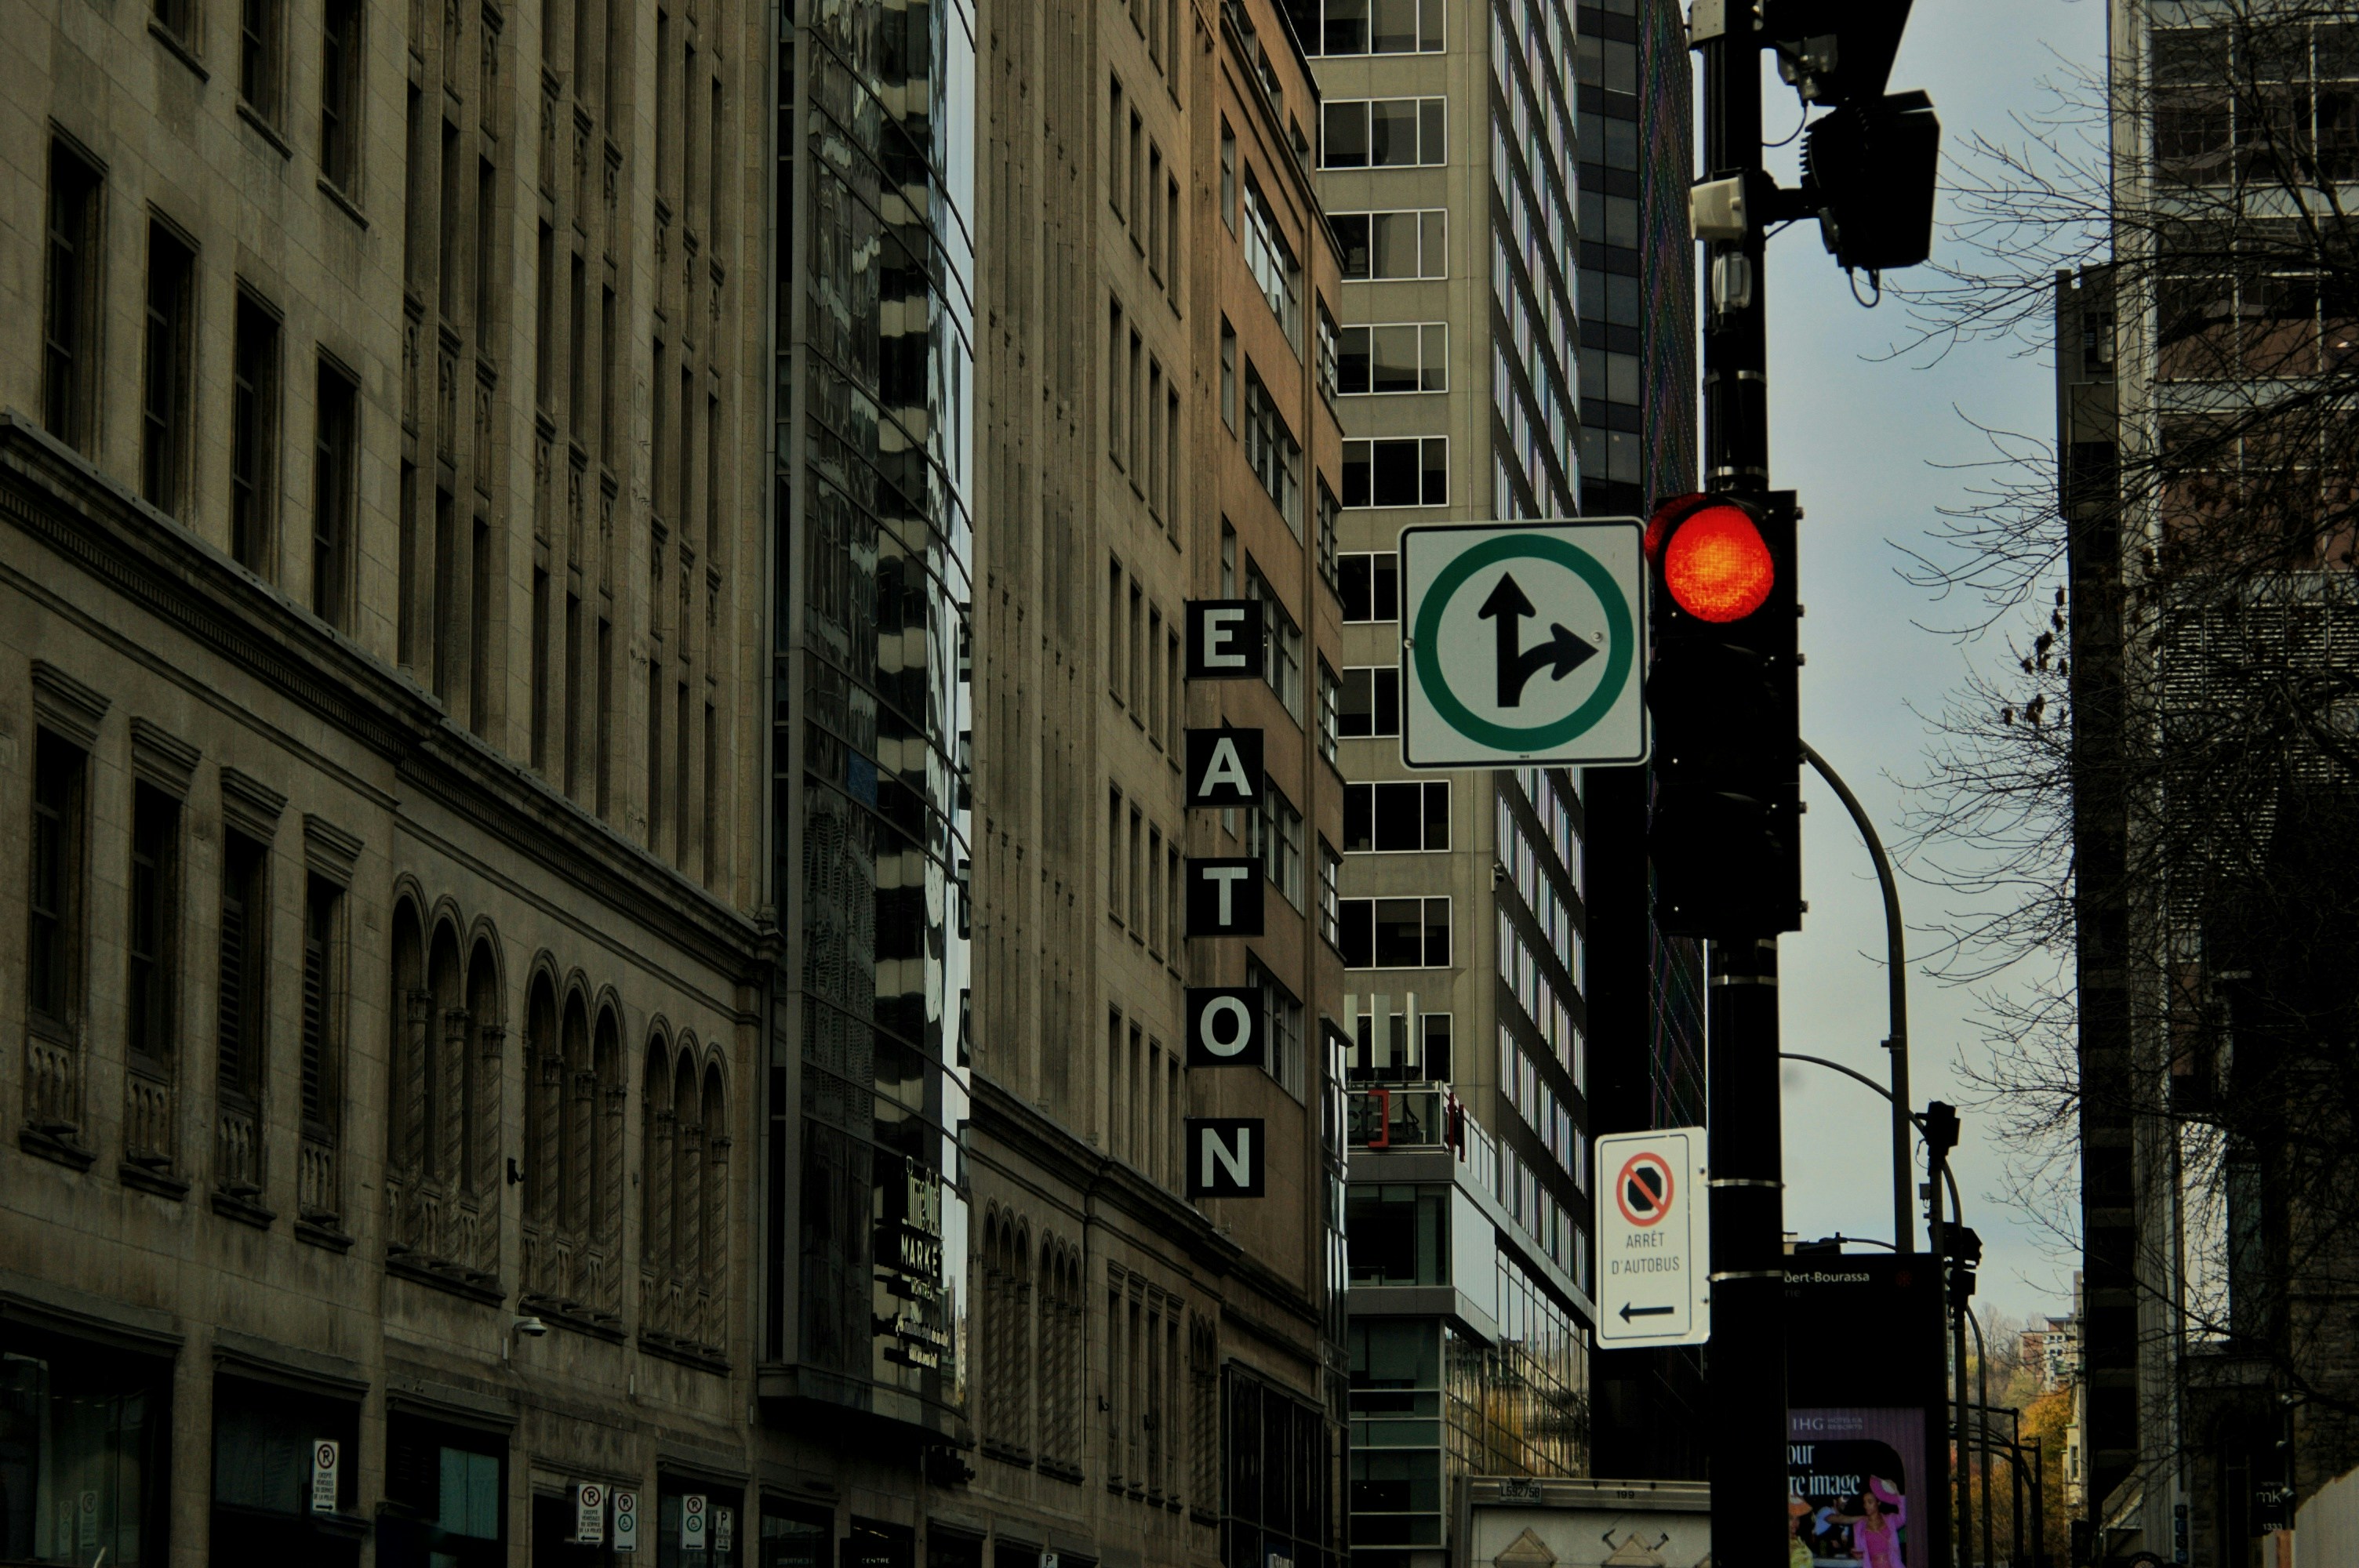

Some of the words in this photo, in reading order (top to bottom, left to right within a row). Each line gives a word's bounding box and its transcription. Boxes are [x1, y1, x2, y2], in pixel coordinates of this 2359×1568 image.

[1198, 609, 1252, 1187] EATON
[1627, 1230, 1664, 1248] ARRÊT
[1612, 1256, 1680, 1275] D'AUTOBUS
[1793, 1417, 1823, 1430] IHG
[1808, 1469, 1860, 1497] image
[1616, 1490, 1634, 1499] 199
[1046, 1555, 1052, 1566] P
